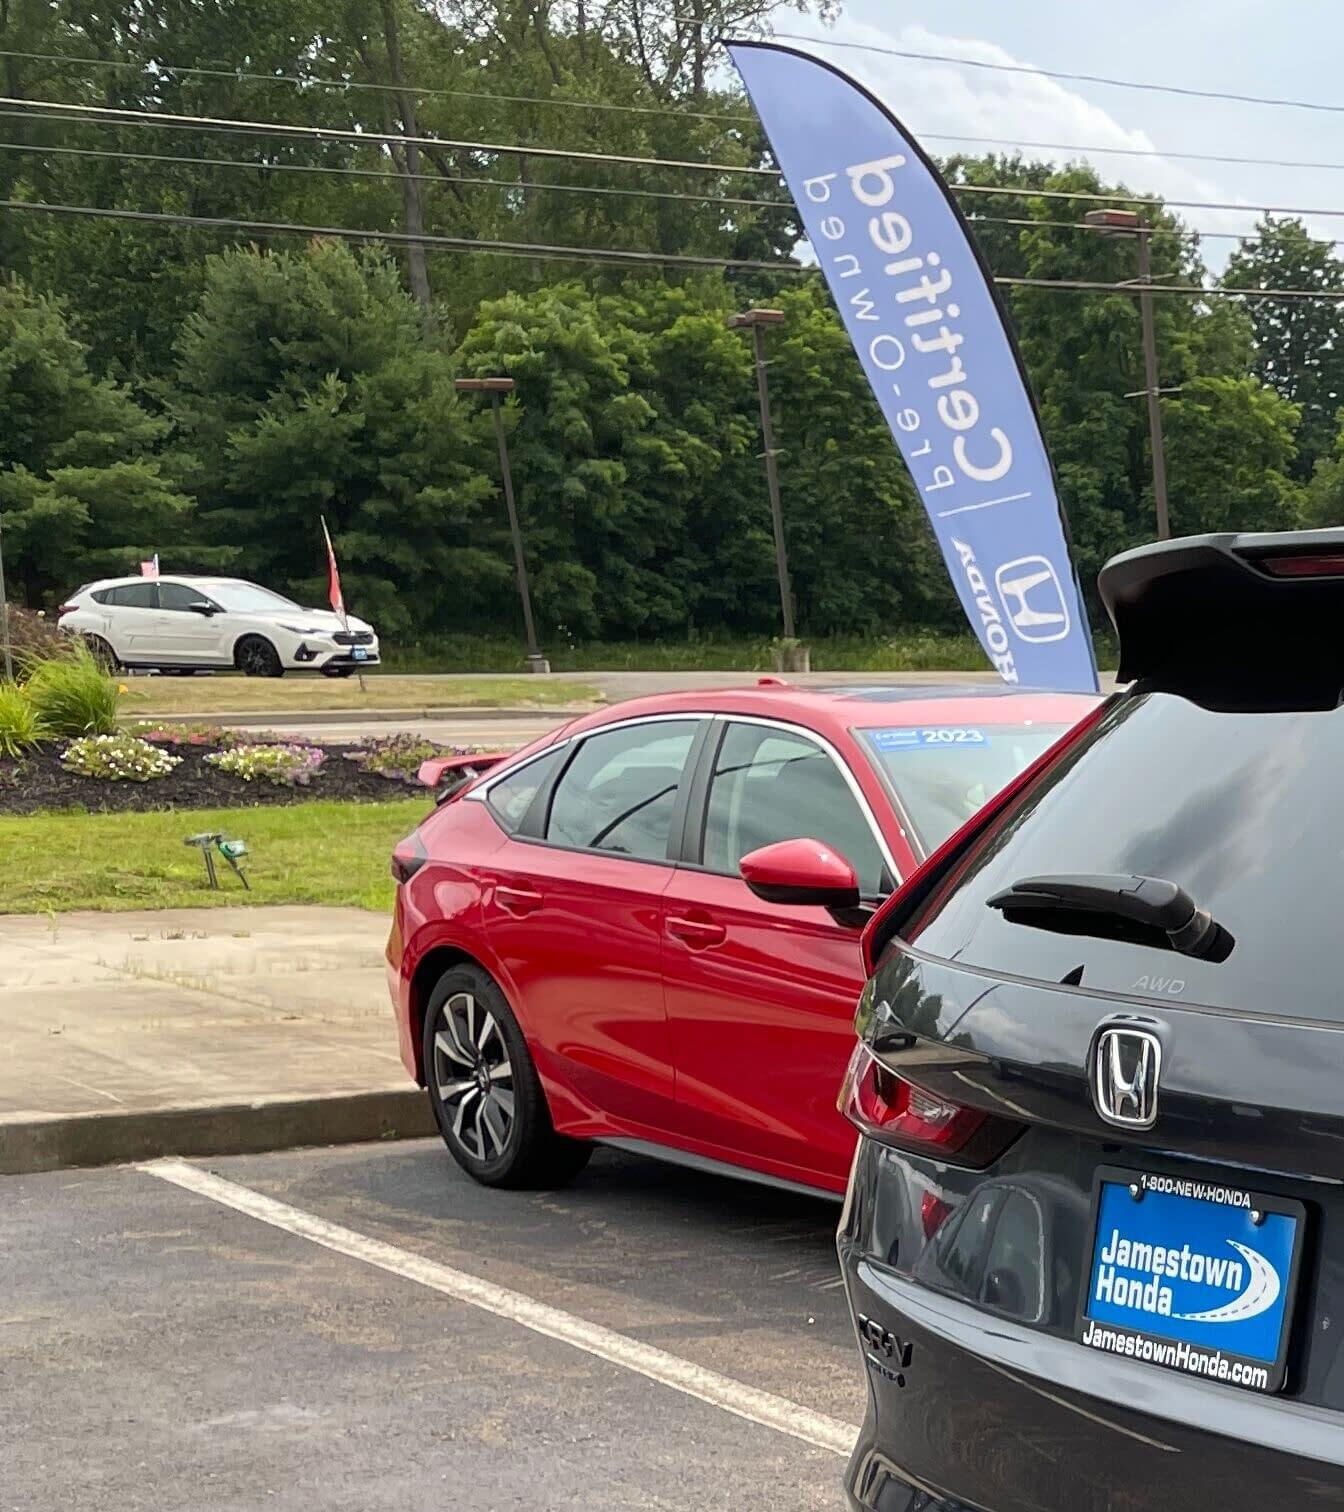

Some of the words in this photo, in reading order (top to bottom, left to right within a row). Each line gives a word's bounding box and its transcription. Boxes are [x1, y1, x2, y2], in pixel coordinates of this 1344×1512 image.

[922, 729, 984, 744] 2023
[1131, 975, 1187, 995] AWD
[1140, 1174, 1252, 1208] 1-800-NEW-HONDA
[1101, 1229, 1243, 1291] Jamestown
[1095, 1264, 1173, 1316] Honda
[1083, 1320, 1268, 1389] JamestownHonda.com
